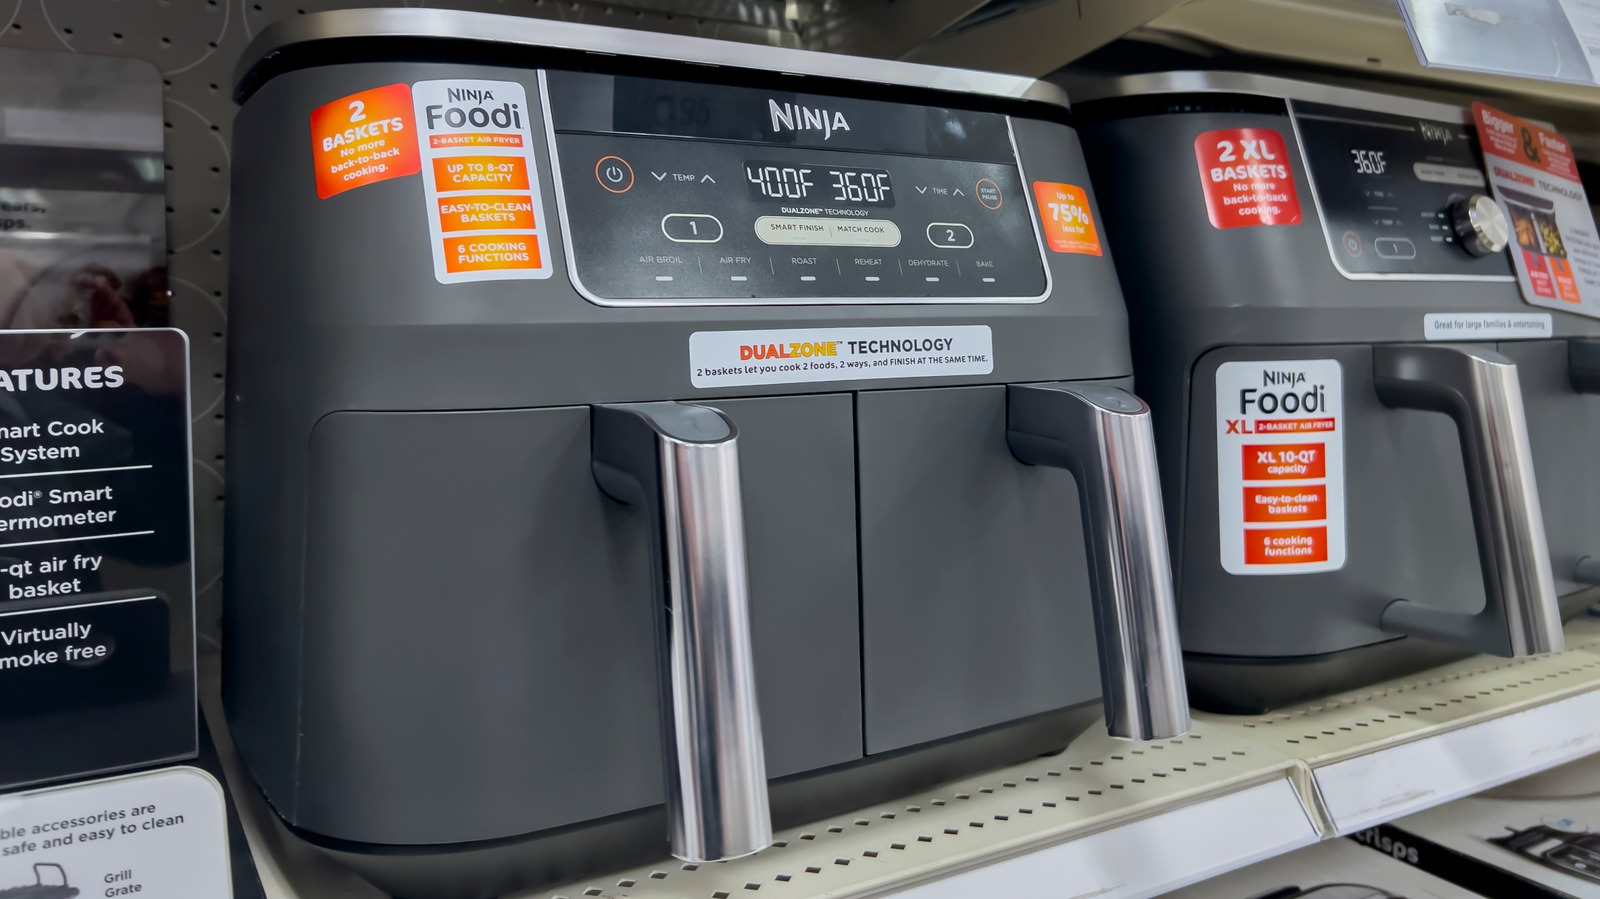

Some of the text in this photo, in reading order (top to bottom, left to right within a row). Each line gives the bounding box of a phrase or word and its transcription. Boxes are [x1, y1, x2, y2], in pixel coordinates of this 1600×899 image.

[448, 88, 494, 104] NINJA
[349, 101, 366, 122] 2
[426, 103, 522, 129] Foodi
[769, 99, 850, 140] NINJA
[1481, 110, 1514, 134] Bigger
[323, 117, 403, 152] BASKETS
[340, 140, 385, 158] No more
[1217, 140, 1274, 162] 2 XL
[331, 148, 400, 173] back-to-back
[447, 164, 463, 172] UP
[1351, 150, 1386, 174] 360F
[344, 164, 388, 181] cooking.
[453, 174, 512, 182] CAPACITY
[1211, 165, 1287, 182] BASKETS
[747, 167, 890, 201] 400F 360F
[1233, 182, 1275, 192] No more
[1056, 192, 1066, 200] Up
[1223, 193, 1288, 205] back-to-back
[441, 203, 531, 214] EASY-TO-CLEAN
[1048, 203, 1089, 225] 75%
[1238, 205, 1280, 215] cooking.
[461, 213, 515, 222] BASKETS
[689, 221, 697, 235] 1
[946, 230, 956, 241] 2
[457, 243, 526, 253] 6 COOKING
[458, 253, 529, 263] FUNCTIONS
[855, 258, 882, 266] REHEAT
[1434, 320, 1452, 329] Great
[1455, 320, 1464, 329] for
[1466, 320, 1481, 330] large
[1484, 320, 1506, 329] families
[1513, 321, 1545, 330] entertaining
[848, 338, 953, 354] TECHNOLOGY
[705, 367, 742, 376] baskets
[745, 365, 757, 373] let
[760, 365, 776, 374] you
[779, 362, 800, 372] cook
[803, 362, 808, 370] 2
[810, 361, 838, 370] foods,
[847, 360, 871, 369] ways,
[928, 356, 943, 364] THE
[946, 356, 965, 364] SAME
[1263, 370, 1306, 388] NINJA
[1240, 384, 1325, 414] Foodi
[48, 419, 104, 436] Cook
[1225, 419, 1253, 434] XL
[1259, 423, 1297, 431] 2-BASKET
[0, 445, 80, 464] System
[1257, 450, 1315, 463] XL 10-QT
[1267, 465, 1307, 475] capacity
[49, 486, 113, 504] Smart
[1255, 494, 1318, 504] Easy-to-clean
[1268, 505, 1307, 514] baskets
[1264, 536, 1312, 546] 6 cooking
[1265, 546, 1312, 556] functions
[39, 557, 67, 573] air
[73, 554, 102, 571] fry
[9, 578, 81, 599] basket
[1, 622, 92, 646] Virtually
[0, 645, 107, 669] moke free
[32, 810, 126, 835] accessories
[131, 804, 156, 816] are
[2, 815, 184, 857] safe and easy to clean
[104, 869, 132, 883] Grill
[105, 884, 142, 898] Grate
